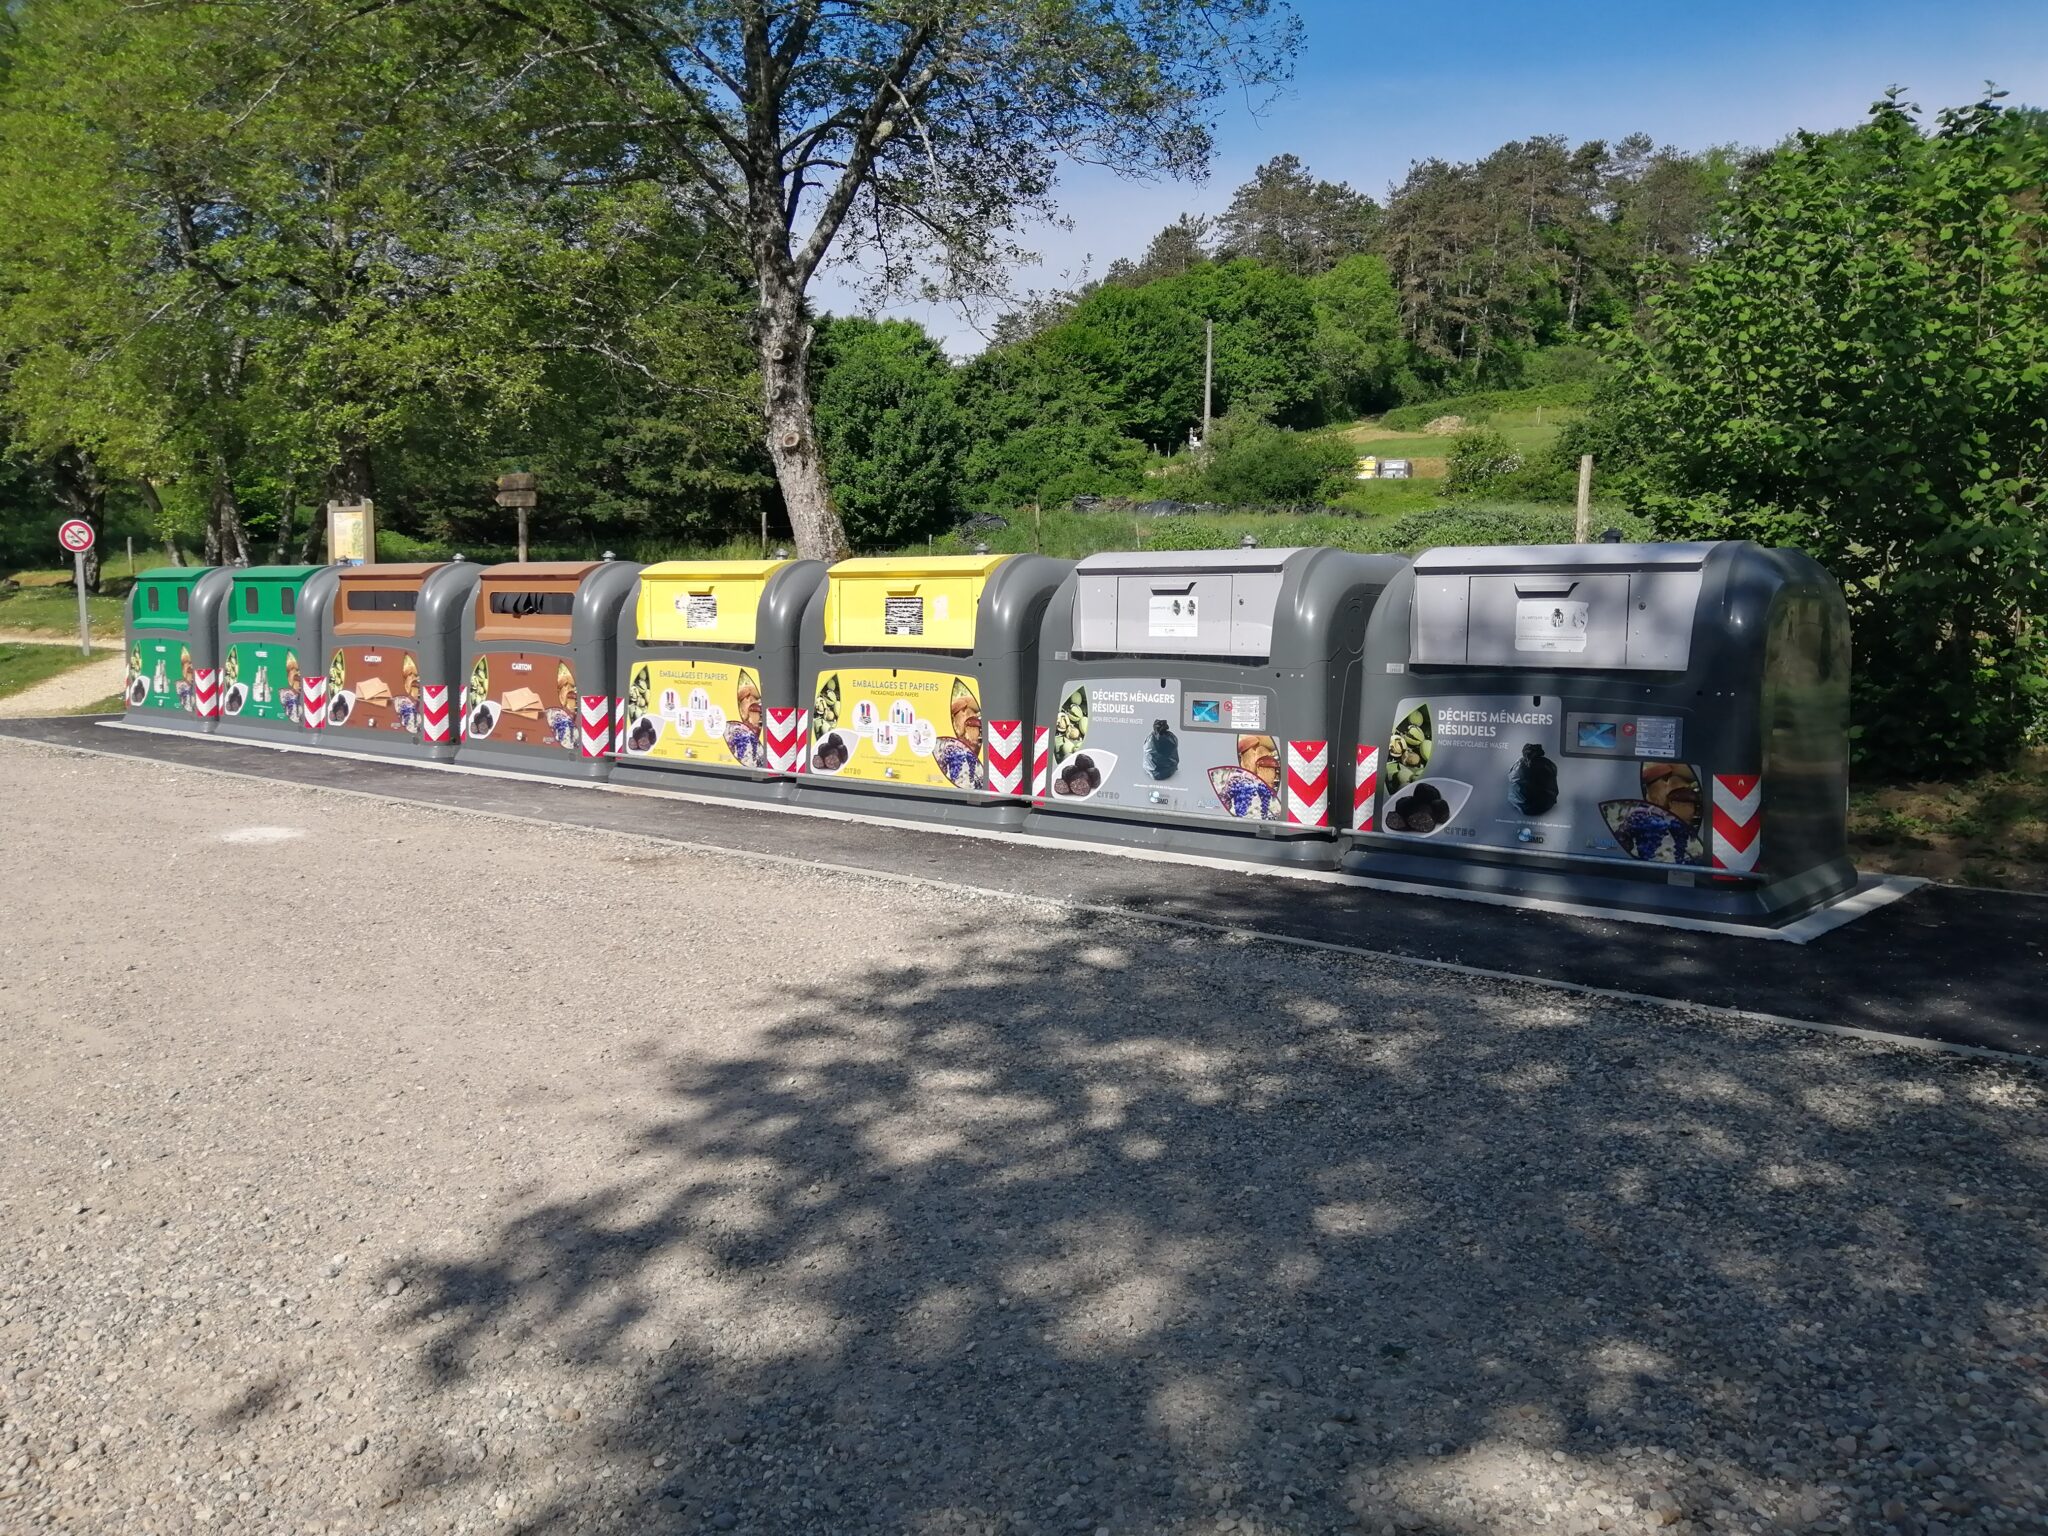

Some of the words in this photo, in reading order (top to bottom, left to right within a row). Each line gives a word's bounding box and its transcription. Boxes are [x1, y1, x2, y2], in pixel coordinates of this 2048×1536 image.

[511, 662, 533, 671] CARTON
[852, 679, 898, 690] EMBALLAGES
[899, 682, 908, 690] ET
[909, 682, 939, 692] PAPIERS
[1092, 688, 1128, 702] DÉCHETS
[1129, 690, 1175, 704] MÉNAGERS
[1092, 701, 1135, 714] RÉSIDUELS
[1438, 707, 1488, 722] DÉCHETS
[1489, 709, 1553, 725] MÉNAGERS
[1438, 722, 1497, 737] RÉSIDUELS
[1452, 740, 1489, 748] RECYCLABLE
